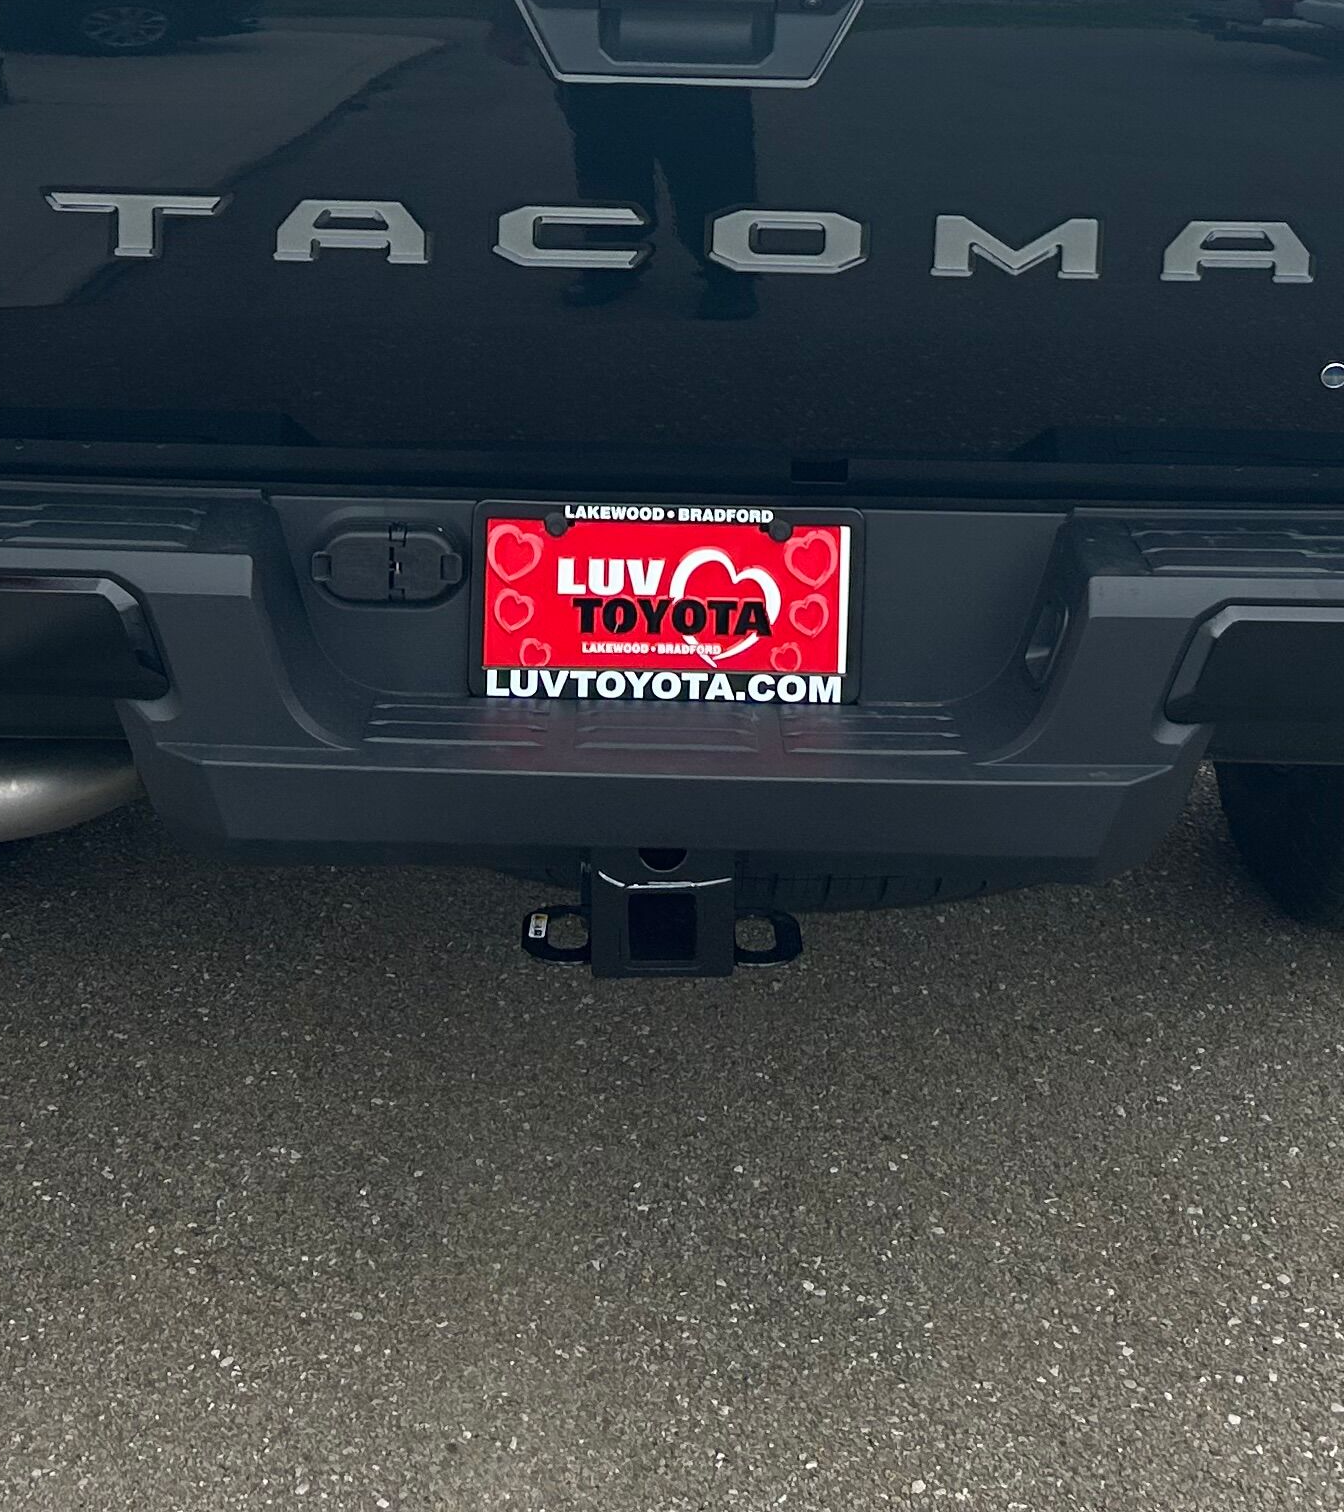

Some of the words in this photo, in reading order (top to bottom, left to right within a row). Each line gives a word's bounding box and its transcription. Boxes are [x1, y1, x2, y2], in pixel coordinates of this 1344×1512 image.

[44, 190, 1316, 284] TACOMA
[564, 504, 665, 522] LAKEWOOD
[678, 507, 774, 524] BRADFORD
[556, 556, 666, 597] LUV
[572, 597, 773, 637] TOYOTA
[581, 642, 650, 655] LAKEWOOD
[657, 642, 722, 656] BRADFORD
[485, 668, 842, 704] LUVTOYOTA.COM
